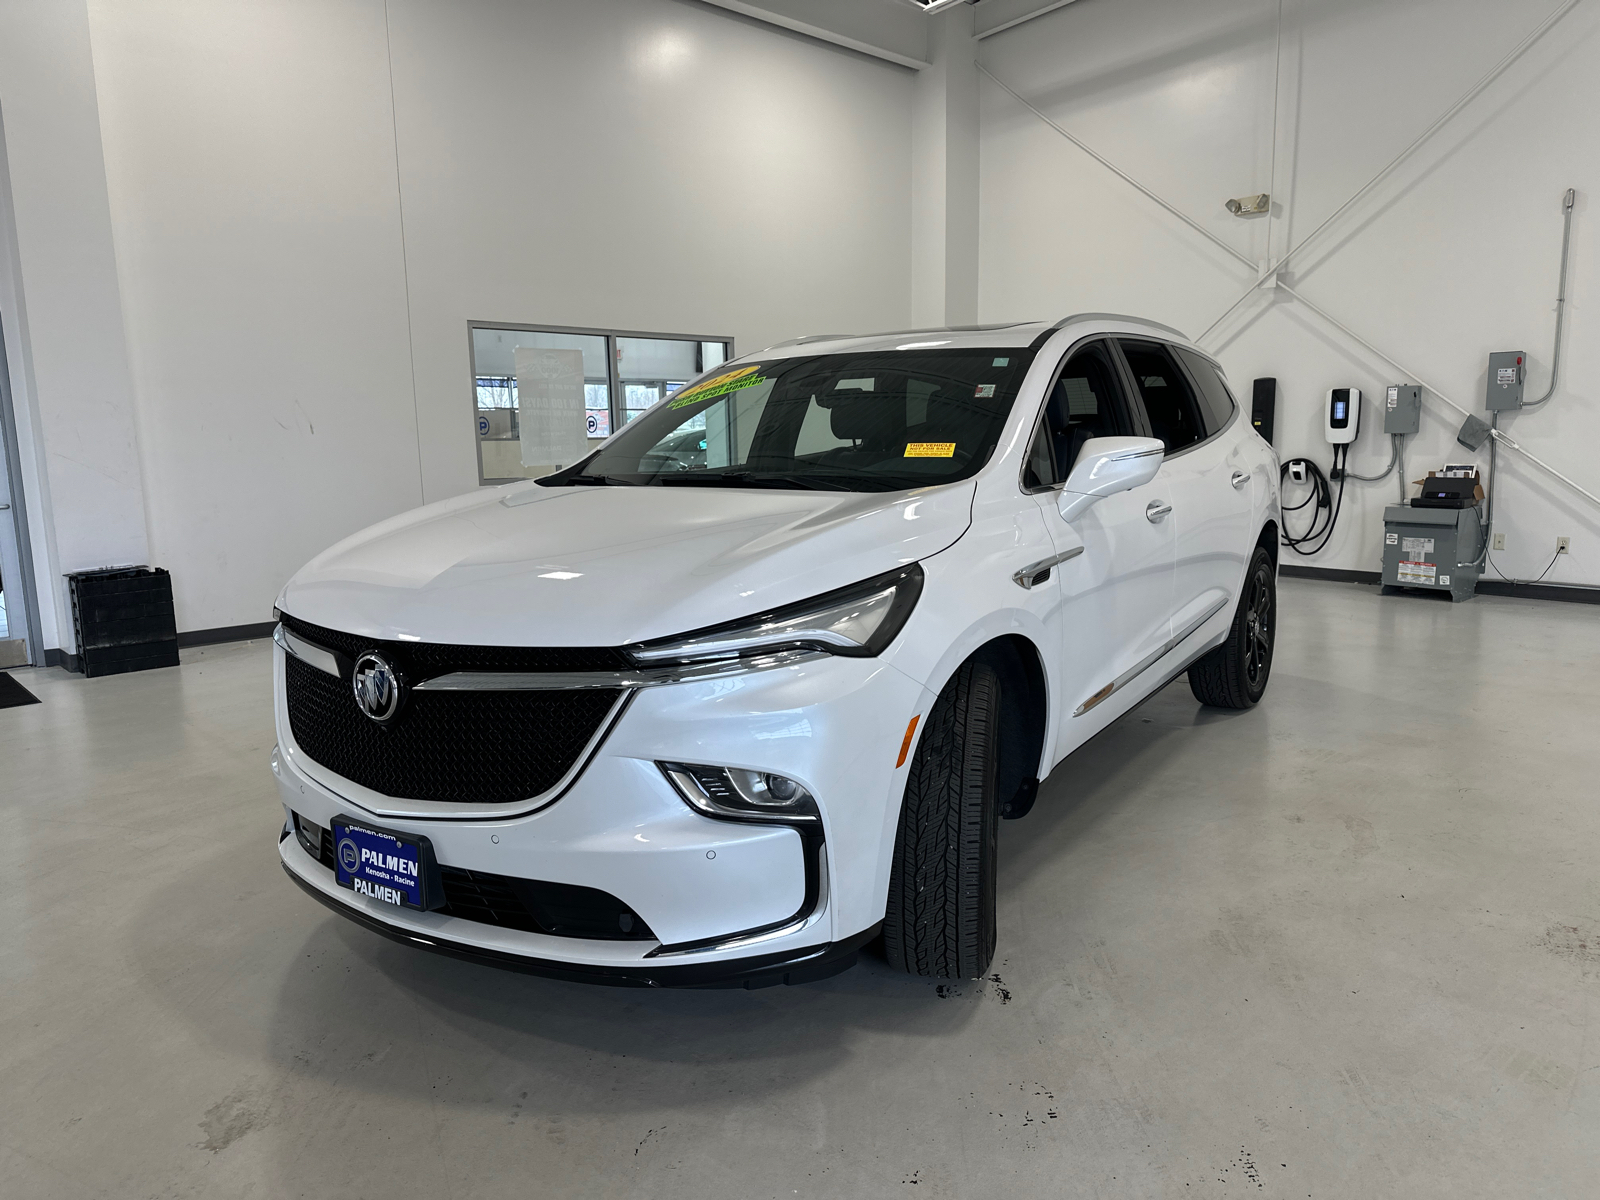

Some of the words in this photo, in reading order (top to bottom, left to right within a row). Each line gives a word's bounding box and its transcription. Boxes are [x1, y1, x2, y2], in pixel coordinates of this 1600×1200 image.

[674, 395, 701, 408] BLIND
[702, 389, 722, 400] SPOT
[724, 378, 765, 393] MONITOR
[349, 825, 396, 841] palmen.com
[361, 848, 418, 877] PALMEN
[365, 867, 390, 880] Kenosha
[394, 875, 415, 887] Racine
[354, 878, 401, 906] PALMEN
